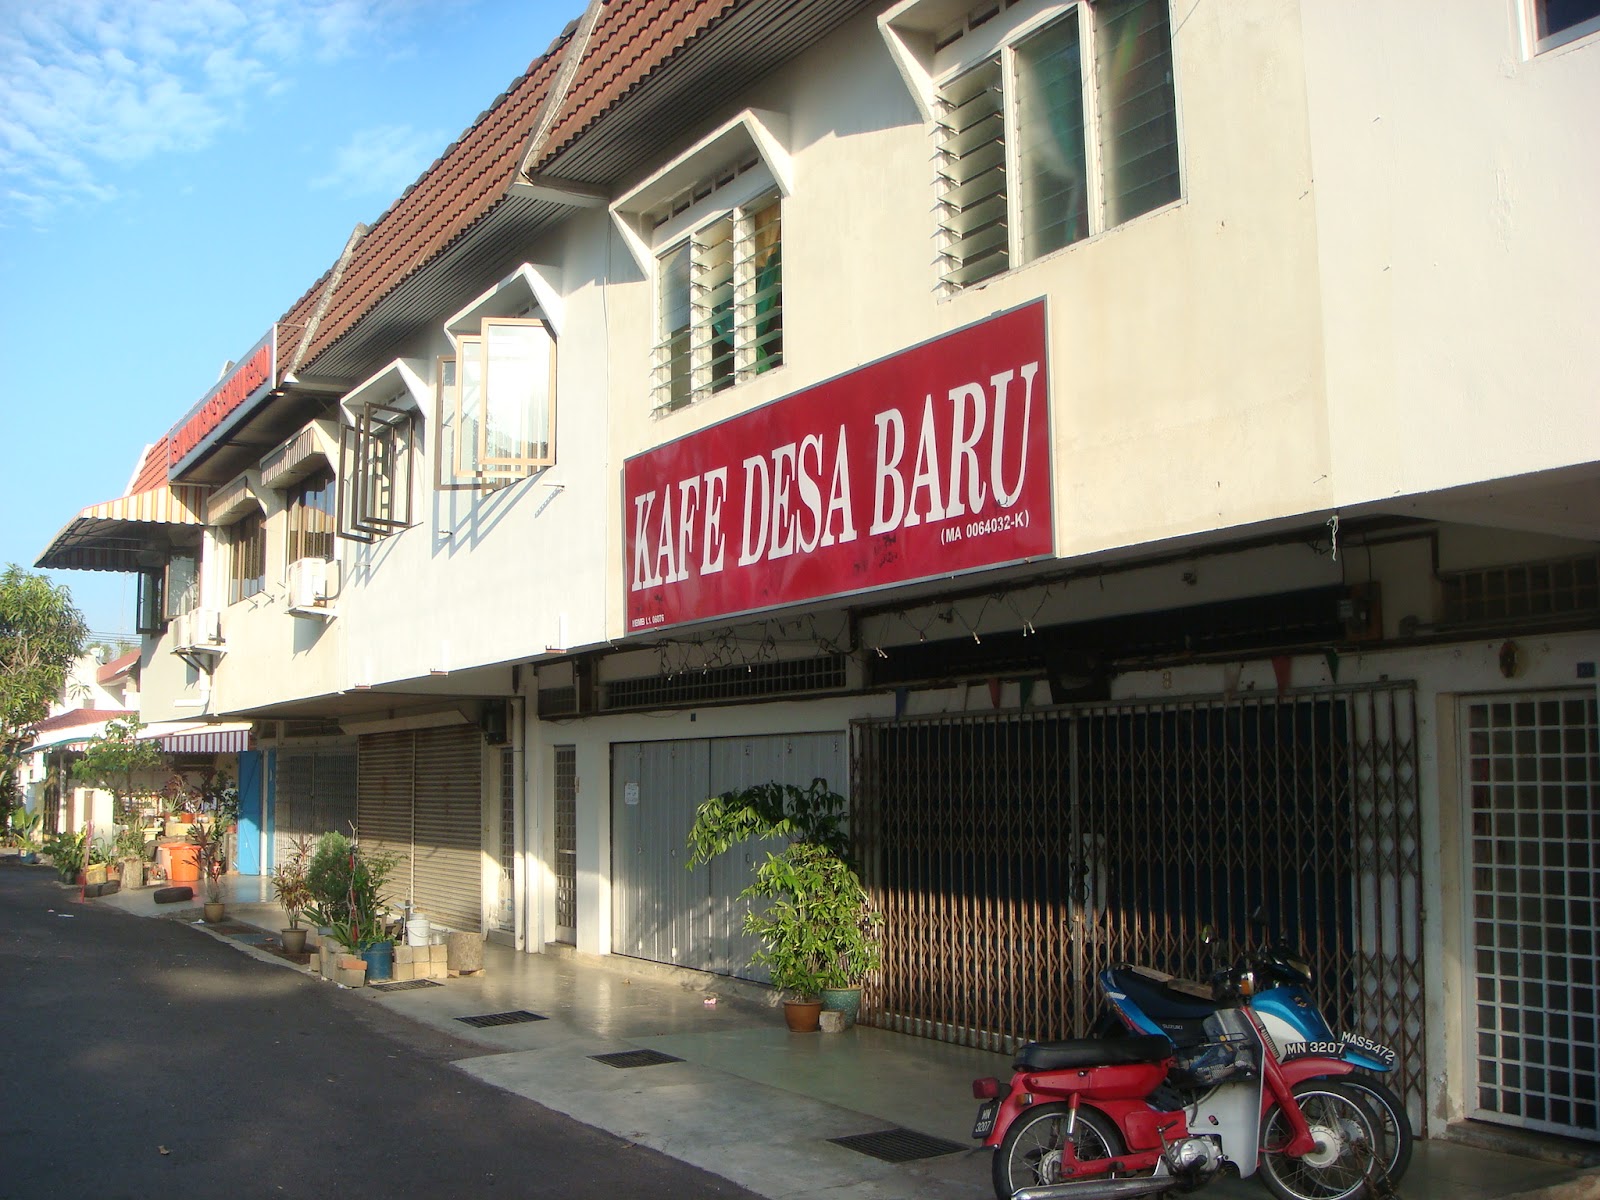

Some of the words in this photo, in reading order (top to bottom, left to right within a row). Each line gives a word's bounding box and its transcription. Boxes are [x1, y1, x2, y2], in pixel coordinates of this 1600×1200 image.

[631, 466, 728, 592] KAFE
[738, 423, 857, 566] DESA
[870, 361, 1038, 534] BARU
[941, 526, 962, 545] (MA
[966, 509, 1029, 538] 0064032-K)
[1286, 1042, 1306, 1055] MN
[1309, 1041, 1346, 1054] 3207
[1341, 1031, 1396, 1062] MAS5472
